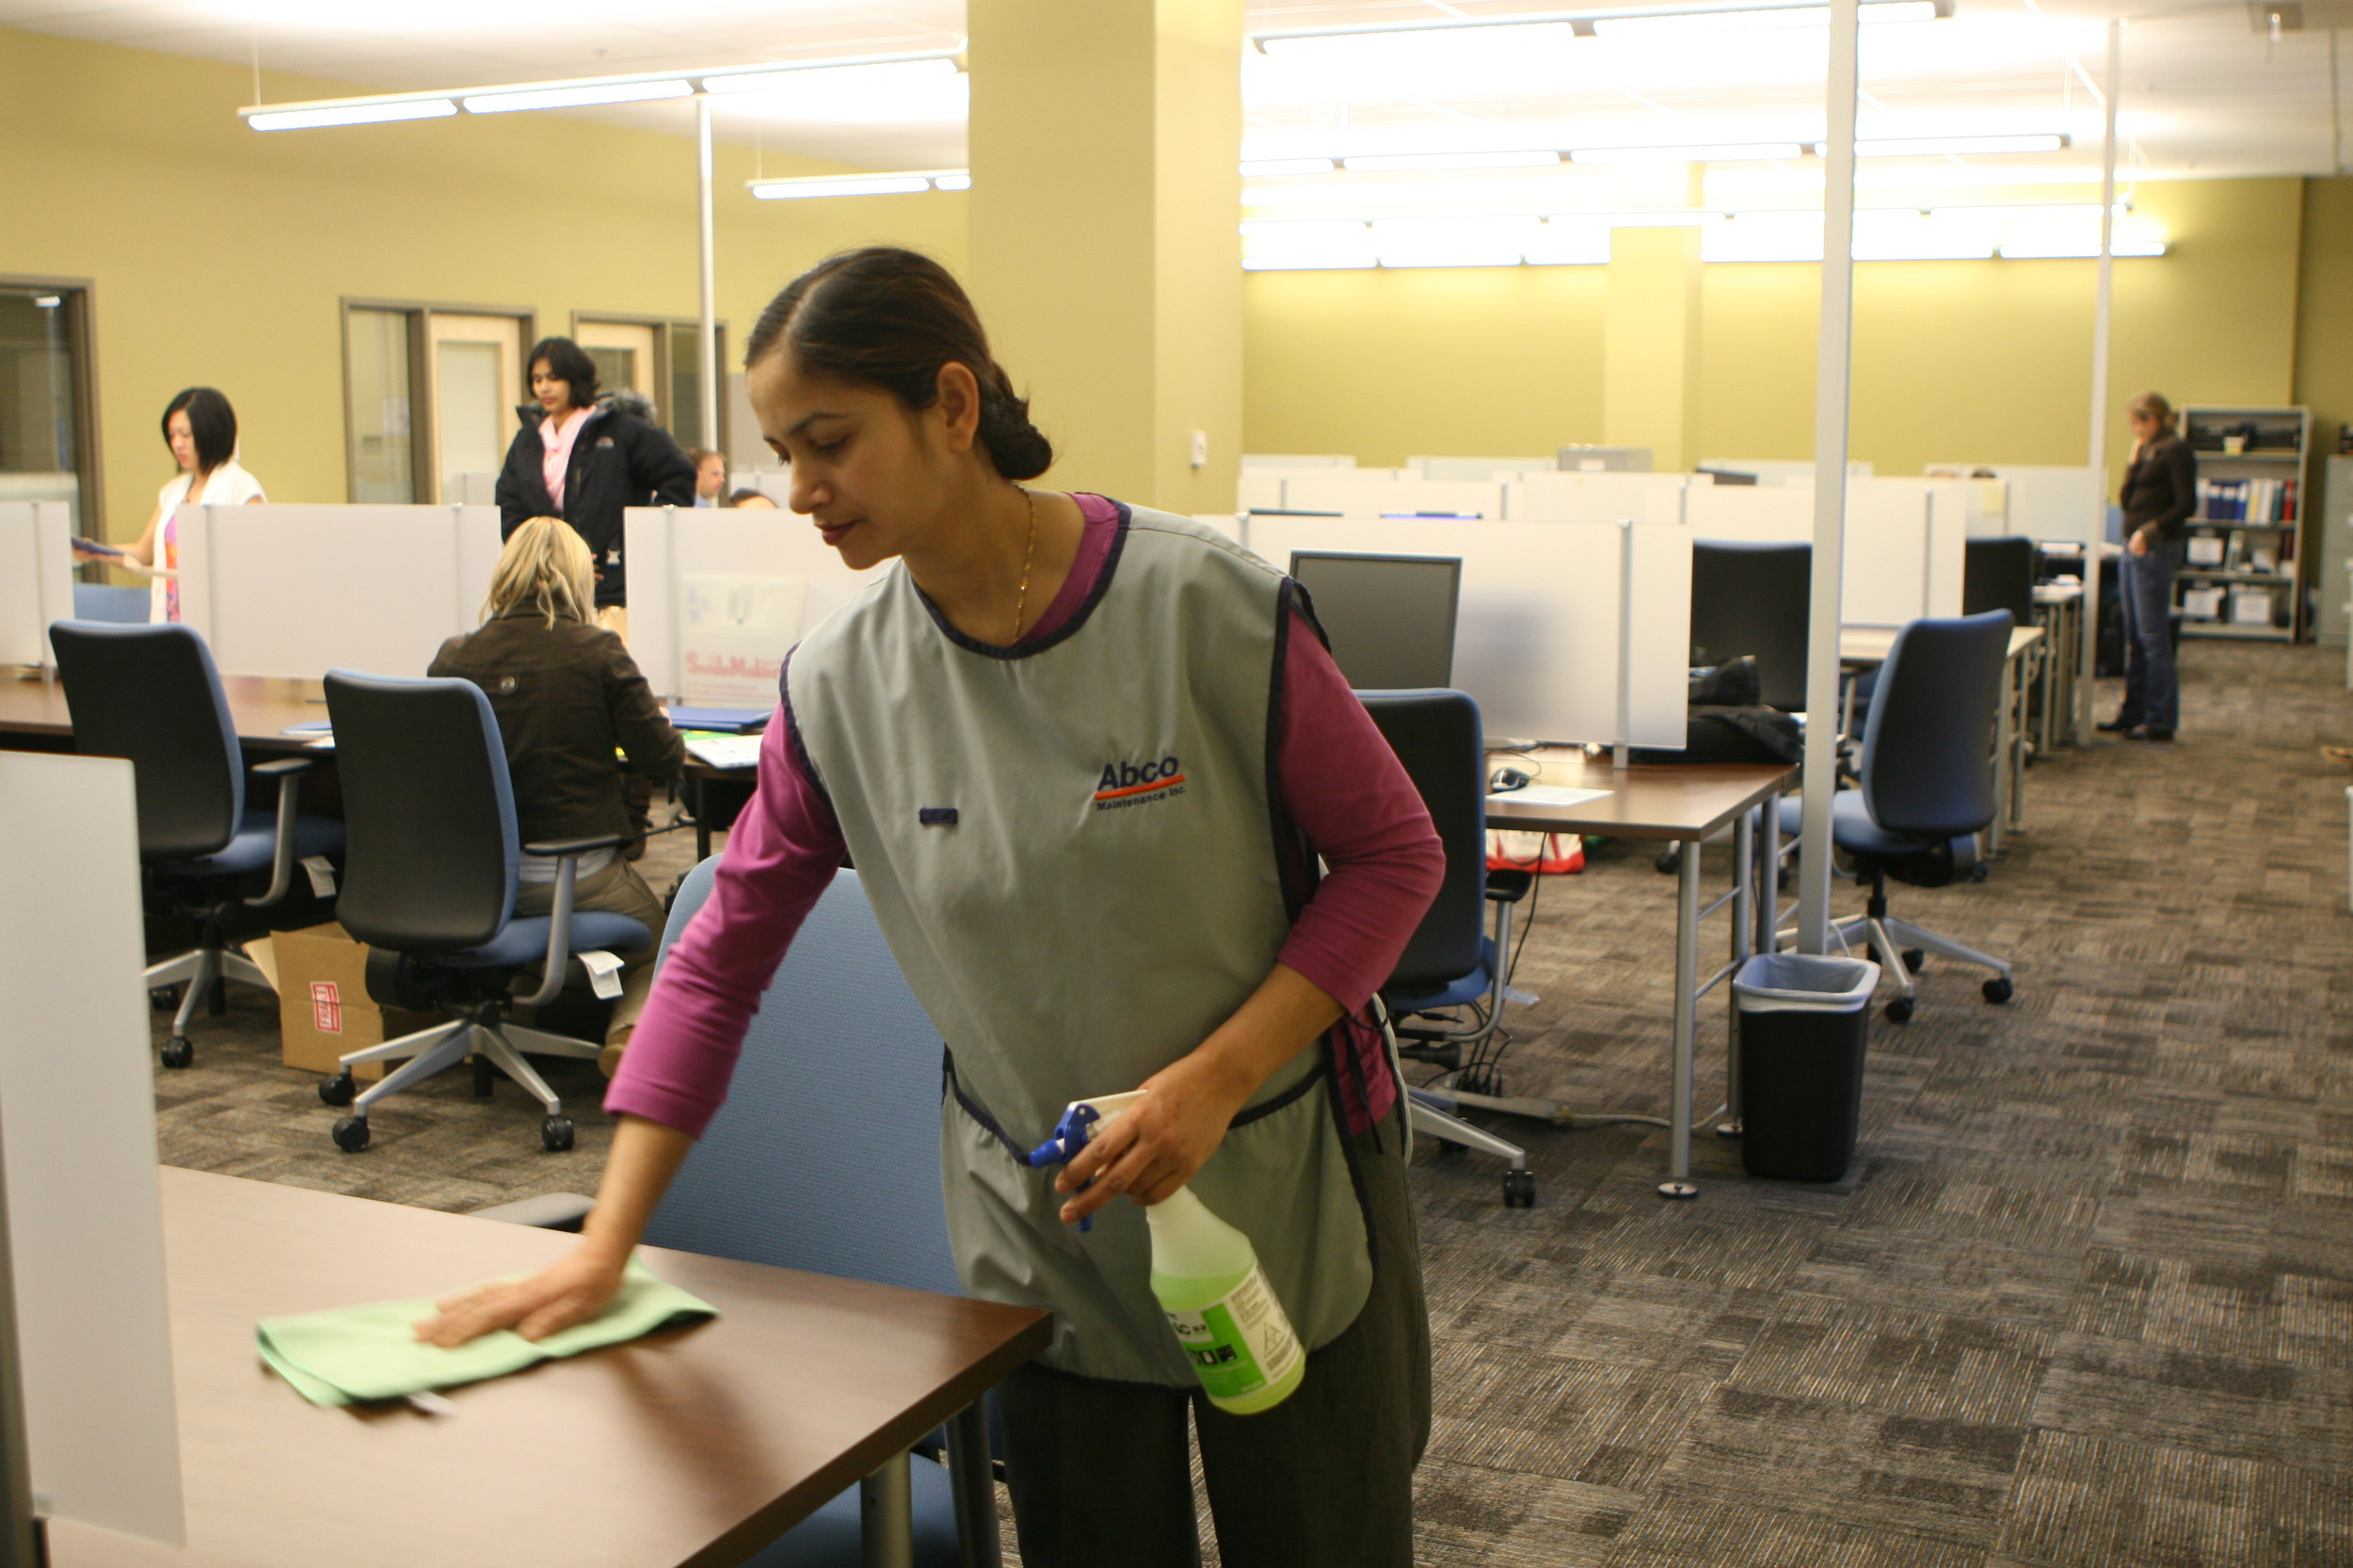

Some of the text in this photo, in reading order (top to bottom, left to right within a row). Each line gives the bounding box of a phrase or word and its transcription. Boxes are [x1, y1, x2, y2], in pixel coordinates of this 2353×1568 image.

[1097, 756, 1178, 791] Abco
[1096, 792, 1165, 810] Maintenance
[315, 986, 330, 1026] FRALE
